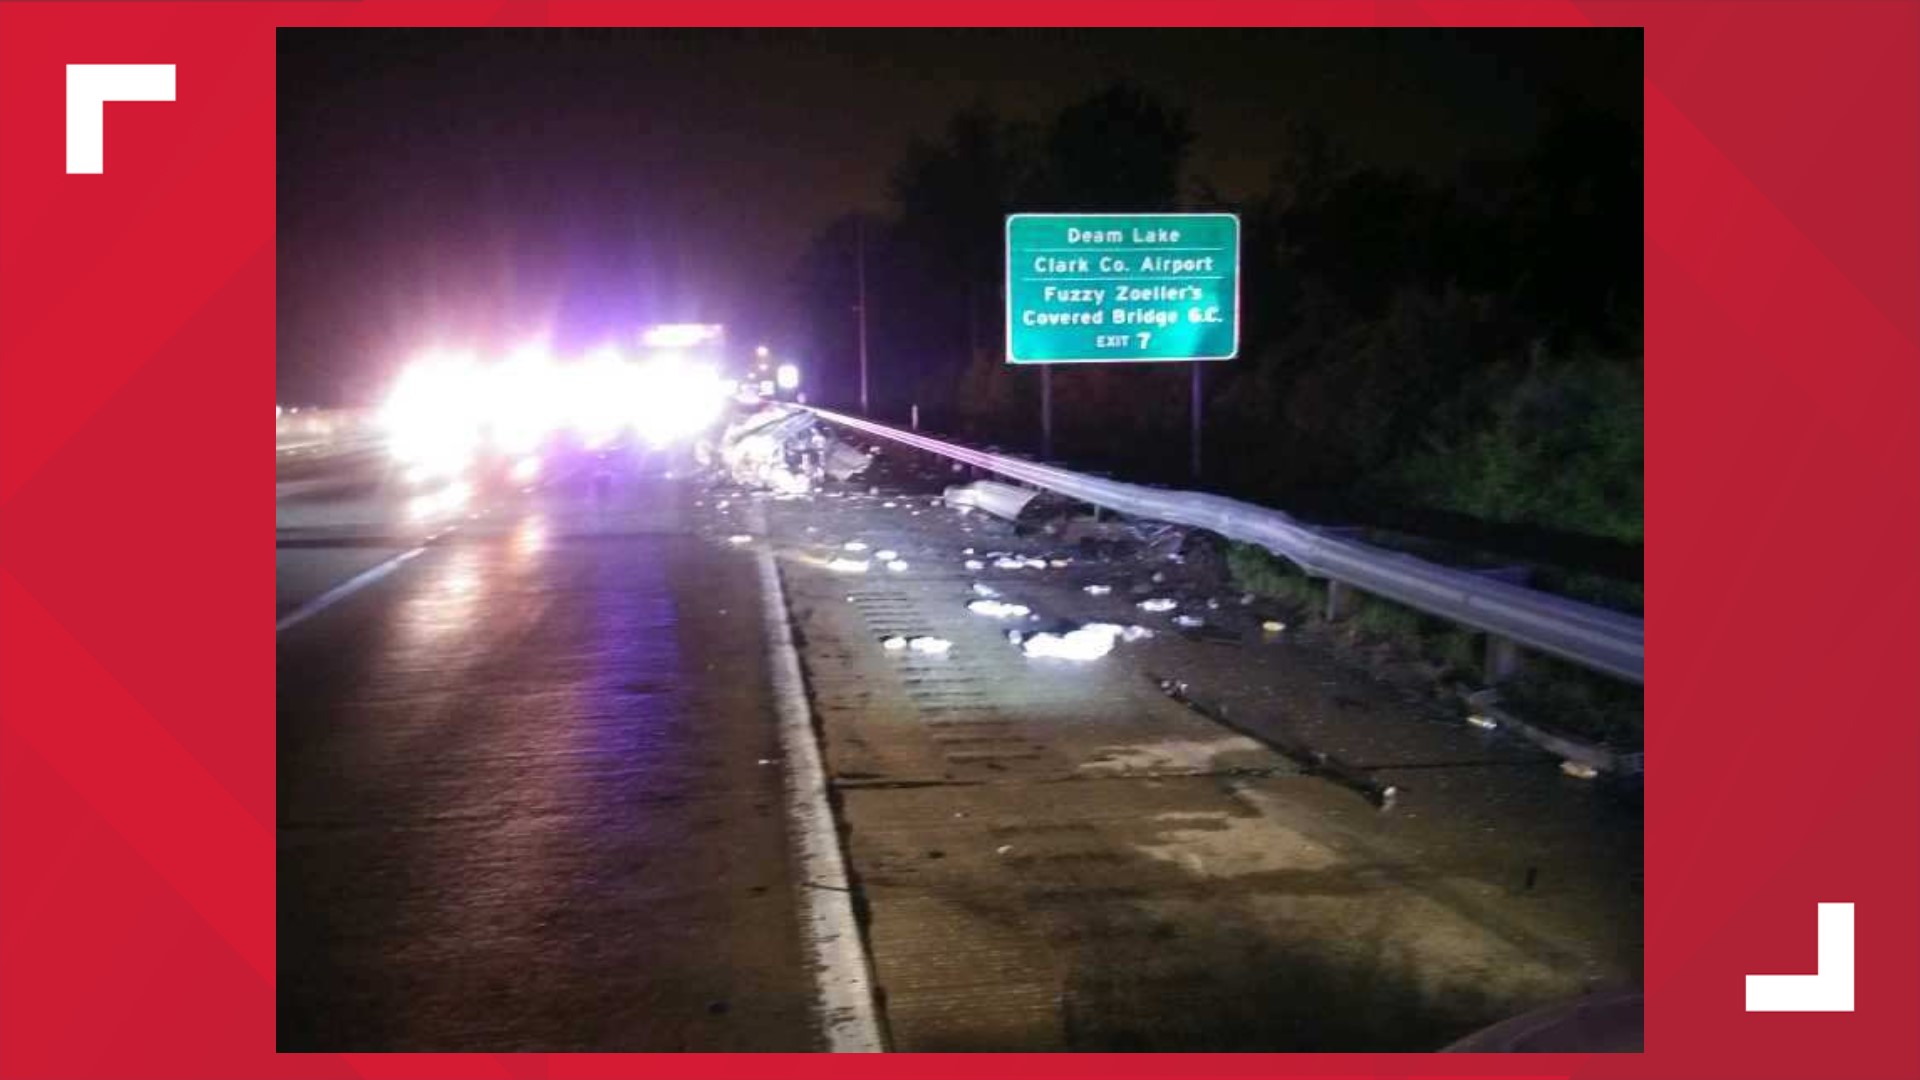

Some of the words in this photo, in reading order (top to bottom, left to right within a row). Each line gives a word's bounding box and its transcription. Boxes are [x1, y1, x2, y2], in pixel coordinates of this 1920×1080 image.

[1067, 227, 1123, 243] Deam
[1132, 227, 1182, 243] Lake
[1033, 256, 1090, 273] Clark
[1099, 256, 1130, 273] Co.
[1140, 256, 1215, 275] Airport
[1043, 285, 1105, 306] Fuzzy
[1115, 285, 1203, 302] Zoeller's
[1022, 309, 1104, 326] Covered
[1112, 308, 1179, 328] Bridge
[1095, 335, 1129, 348] EXIT
[1137, 332, 1152, 350] 7
